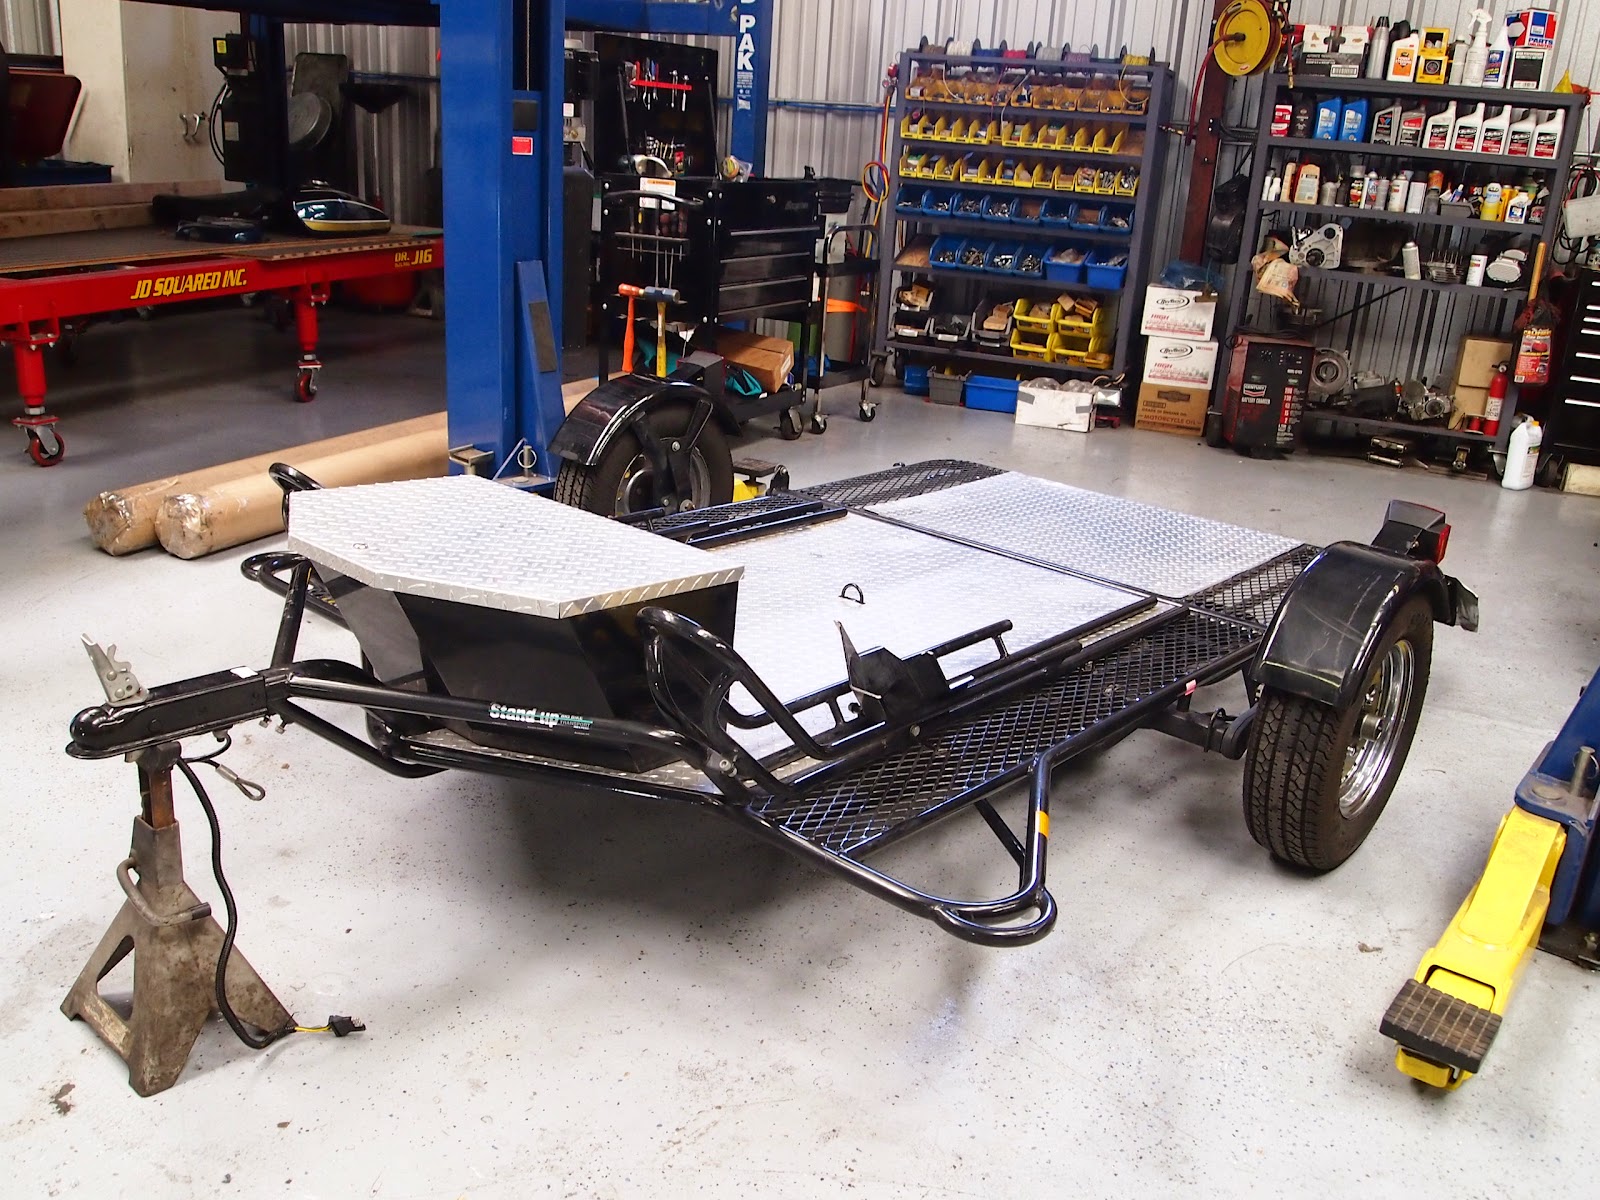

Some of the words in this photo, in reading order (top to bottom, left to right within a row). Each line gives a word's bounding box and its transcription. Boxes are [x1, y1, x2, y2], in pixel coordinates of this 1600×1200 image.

[737, 14, 756, 71] PAK
[1529, 37, 1553, 45] PARTS
[394, 251, 410, 262] DR.
[411, 248, 433, 265] JIG
[130, 279, 153, 300] JD
[152, 271, 222, 297] SQUARED
[221, 268, 248, 288] INC.
[1143, 414, 1185, 424] MOTORCYCLE
